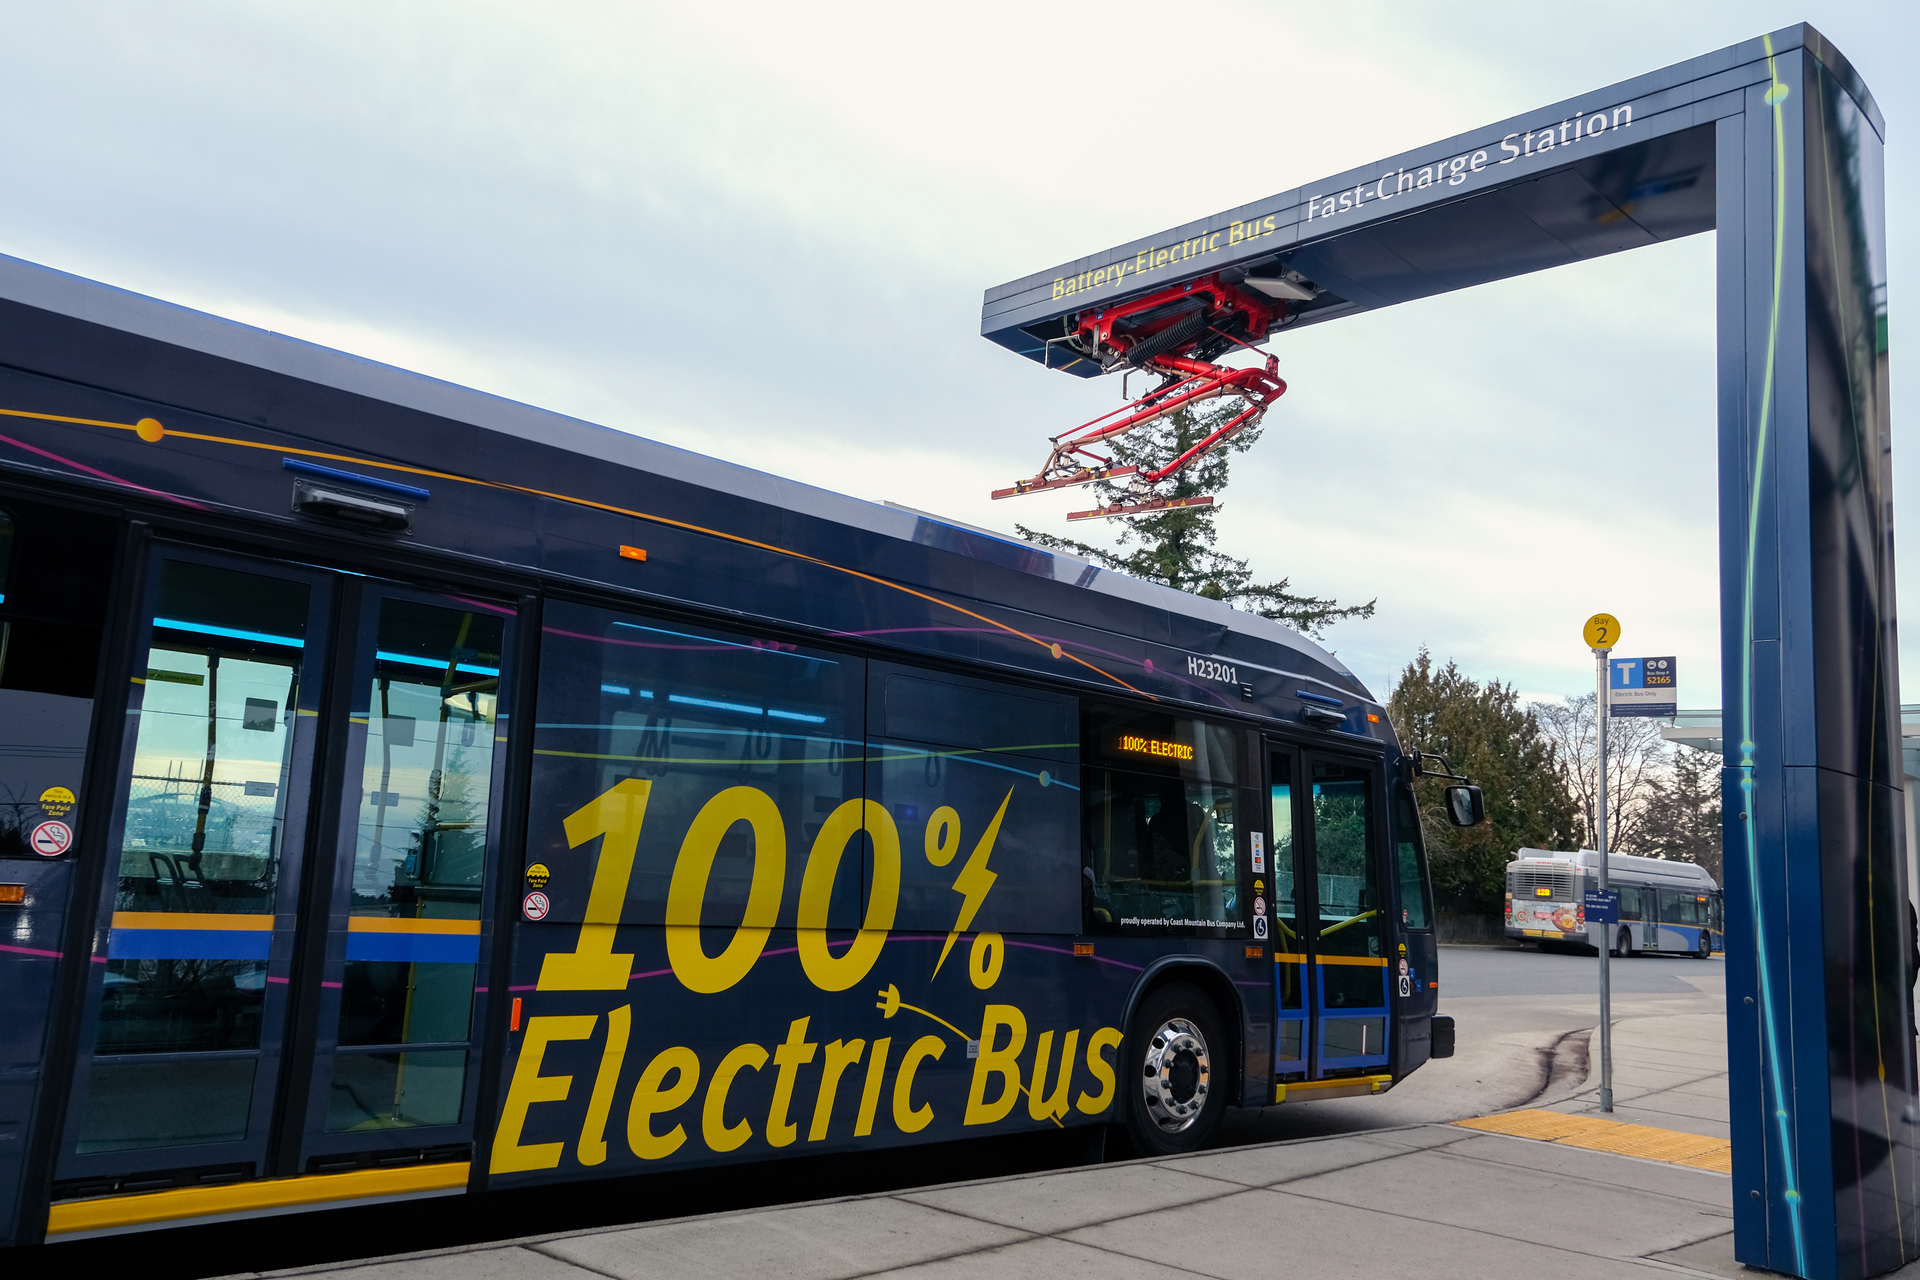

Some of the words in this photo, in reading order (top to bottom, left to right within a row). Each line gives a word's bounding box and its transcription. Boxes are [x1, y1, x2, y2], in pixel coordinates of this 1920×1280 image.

[1052, 230, 1221, 301] Battery-Electric
[1228, 215, 1276, 247] Bus
[1307, 149, 1488, 223] Fast-Charge
[1498, 103, 1633, 165] Station
[1594, 617, 1610, 626] Bay
[1596, 627, 1608, 644] 2
[1187, 656, 1238, 684] H23201
[1617, 662, 1636, 685] T
[1646, 676, 1671, 684] 52165
[1123, 735, 1147, 753] 100%
[1151, 740, 1193, 760] ELECTRIC
[535, 777, 1015, 994] 100%
[1120, 917, 1140, 926] proudly
[1140, 918, 1162, 926] operated
[1162, 918, 1170, 927] by
[1170, 918, 1184, 926] Coast
[1184, 918, 1206, 926] Mountain
[1207, 919, 1216, 927] Bus
[1216, 919, 1236, 929] Company
[1236, 920, 1246, 928] Ltd.
[489, 1004, 946, 1176] Electric
[963, 1004, 1124, 1126] Bus
